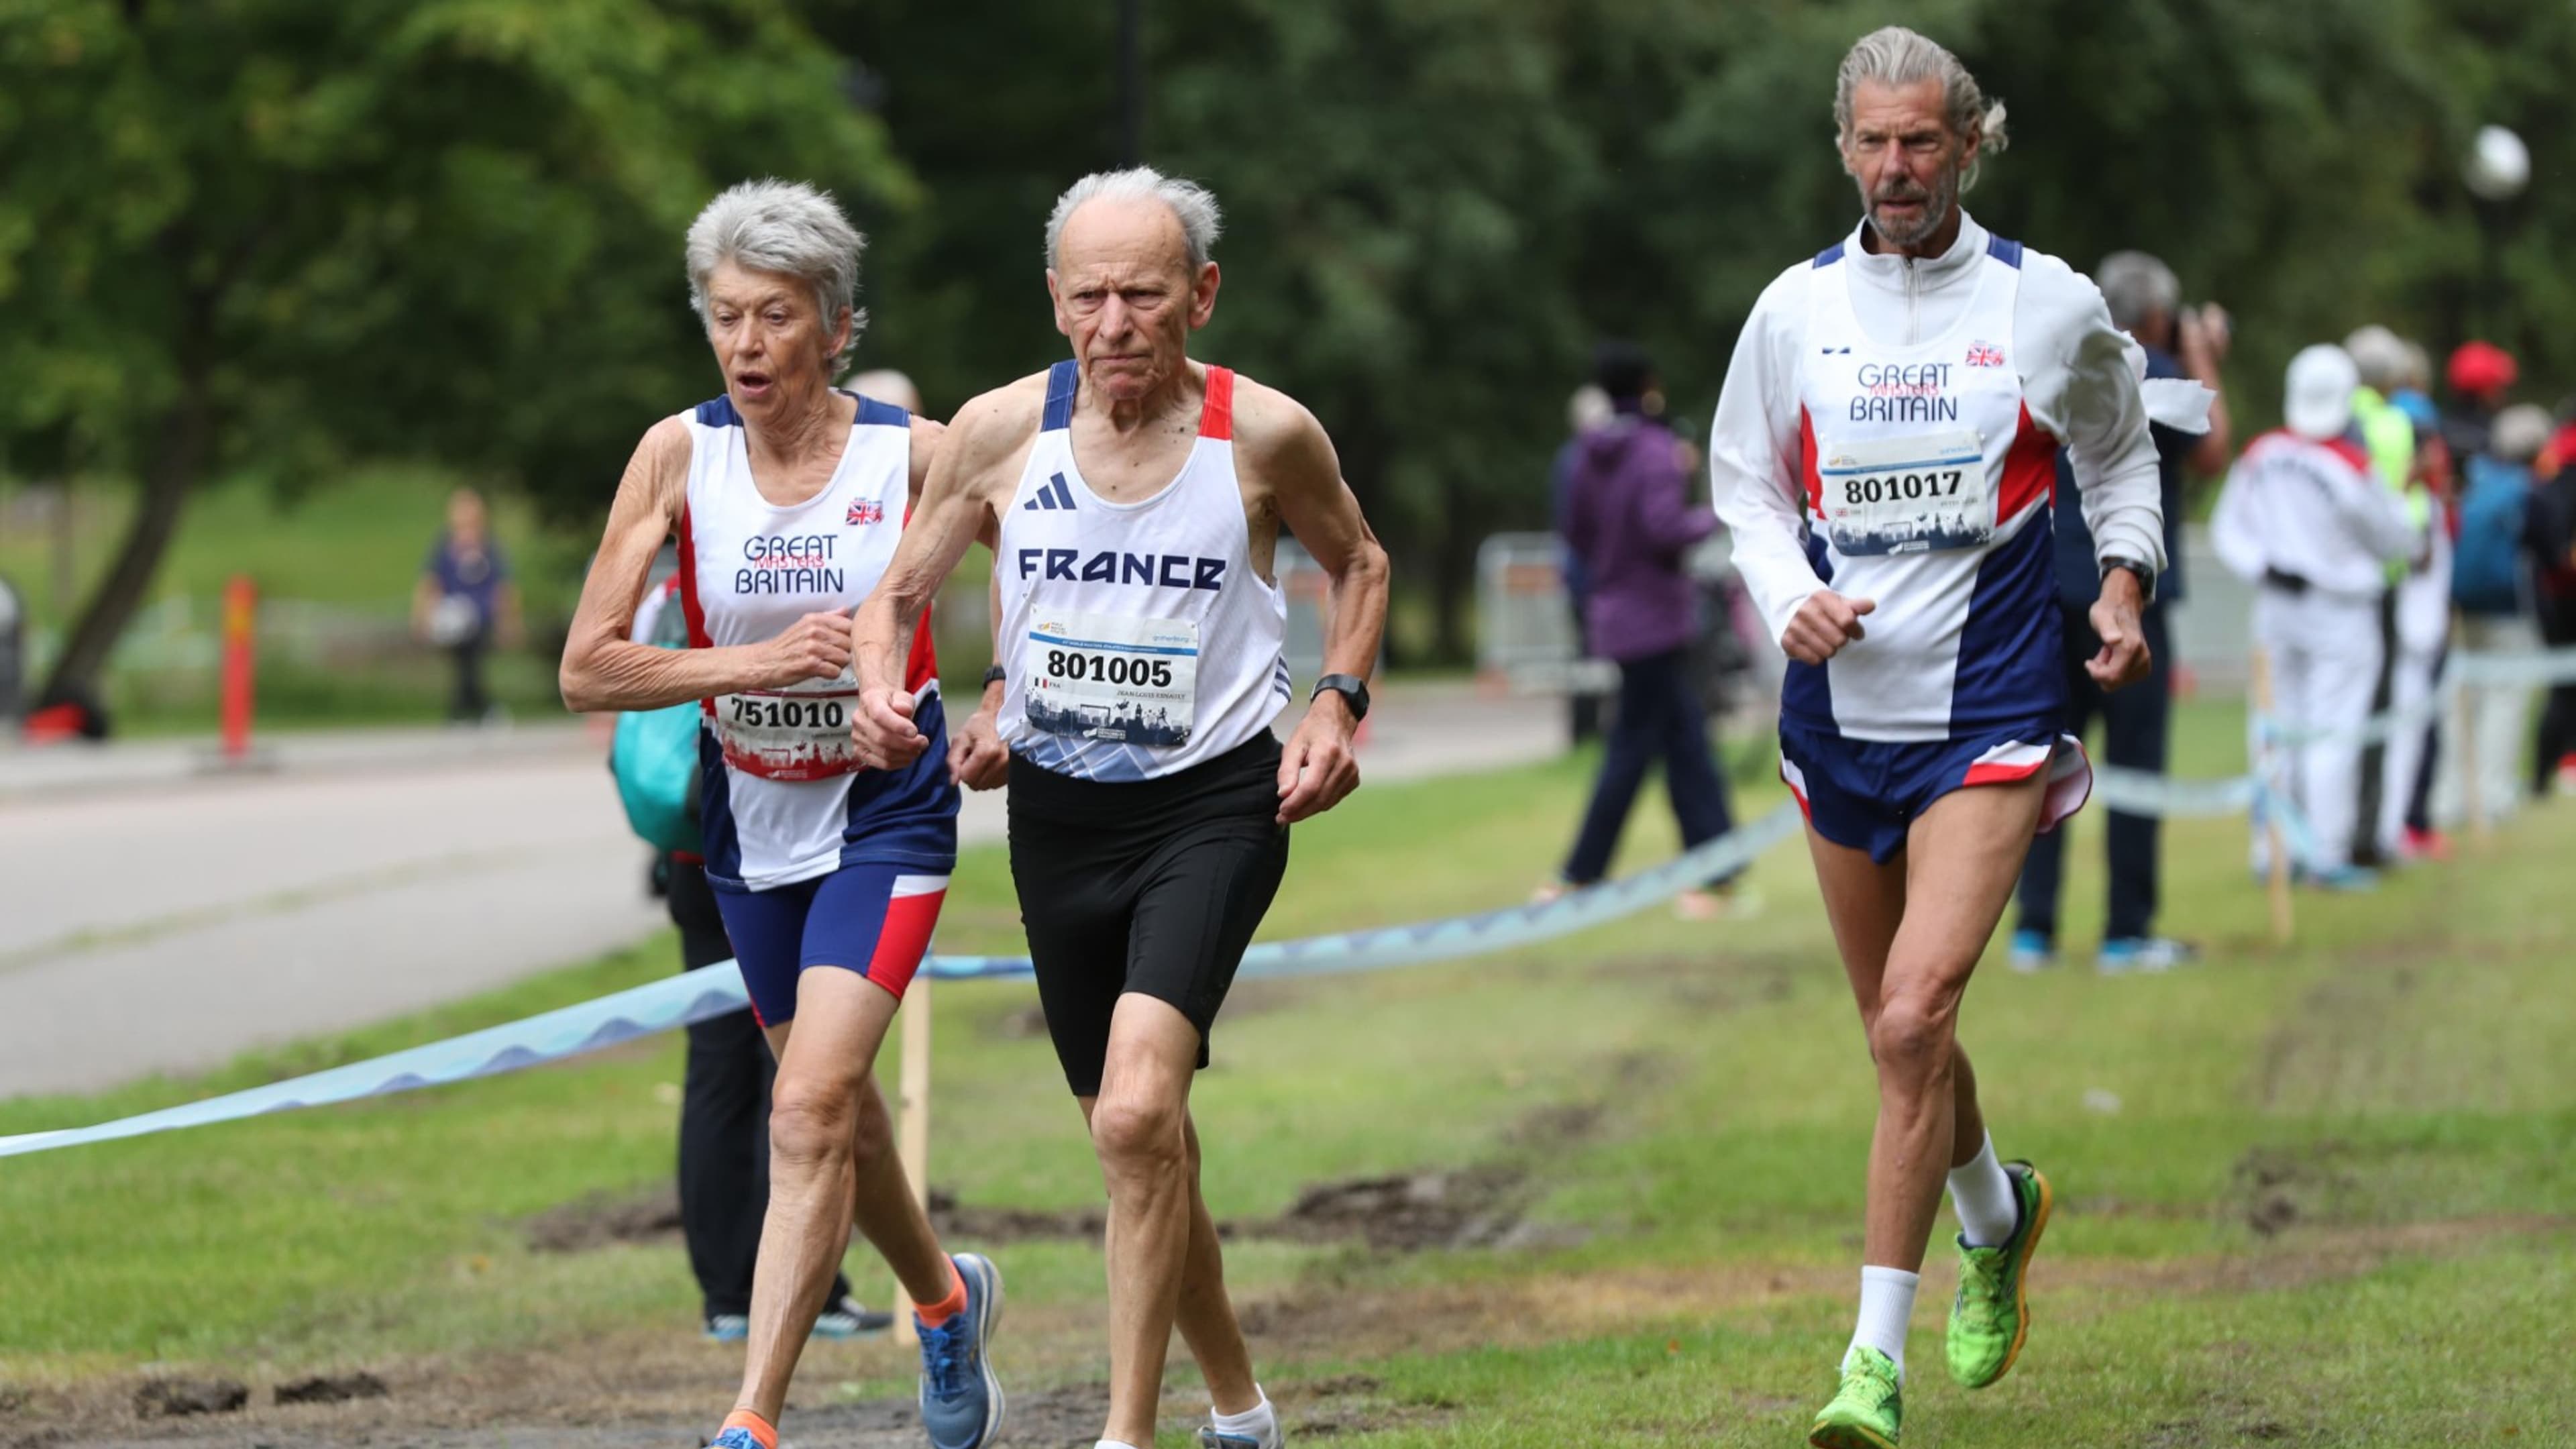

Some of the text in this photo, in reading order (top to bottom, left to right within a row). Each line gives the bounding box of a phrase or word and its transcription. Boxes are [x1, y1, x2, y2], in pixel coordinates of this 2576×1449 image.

[1858, 363, 1953, 388] GREAT
[1849, 396, 1957, 422] BRITAIN
[1845, 470, 1962, 504] 801017
[744, 535, 839, 561] GREAT
[754, 555, 824, 569] MASTERS
[1018, 548, 1226, 591] FRANCE
[735, 568, 844, 594] BRITAIN
[1047, 649, 1172, 688] 801005
[731, 696, 844, 729] 751010
